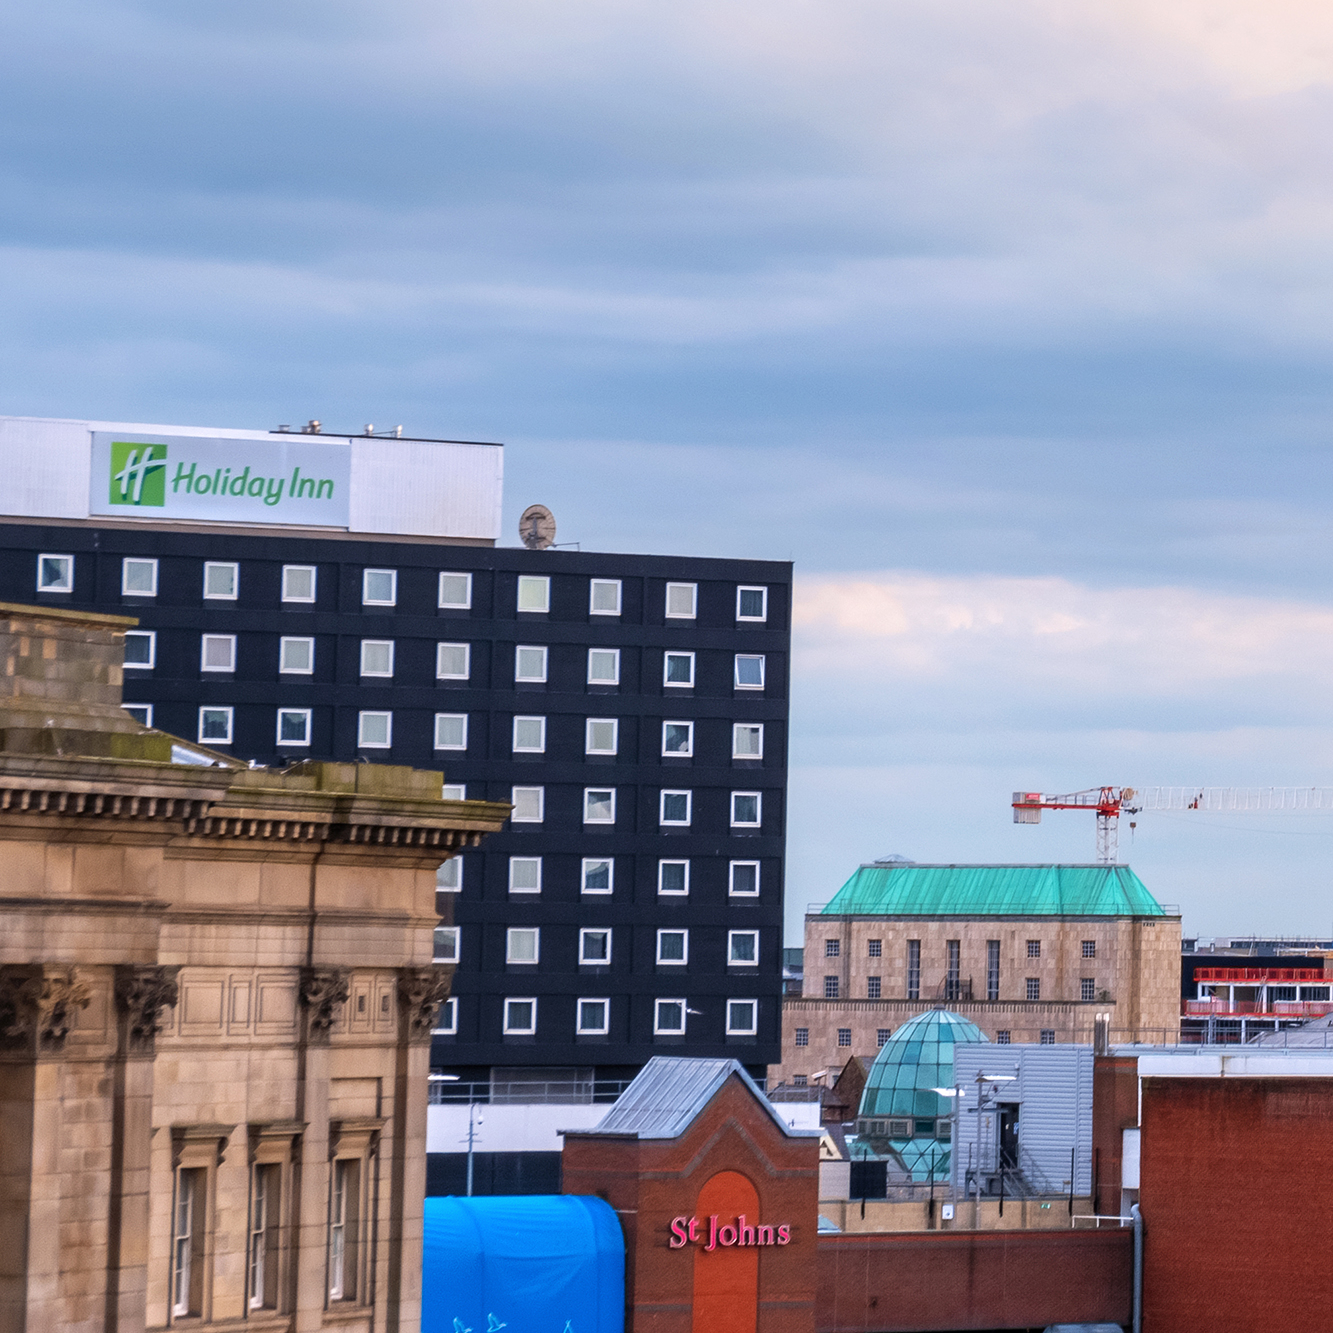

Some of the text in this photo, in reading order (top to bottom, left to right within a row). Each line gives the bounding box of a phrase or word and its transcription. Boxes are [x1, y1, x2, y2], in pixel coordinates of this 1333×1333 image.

[171, 461, 285, 506] Holiday
[289, 467, 334, 499] Inn
[669, 1215, 791, 1251] St Johns
